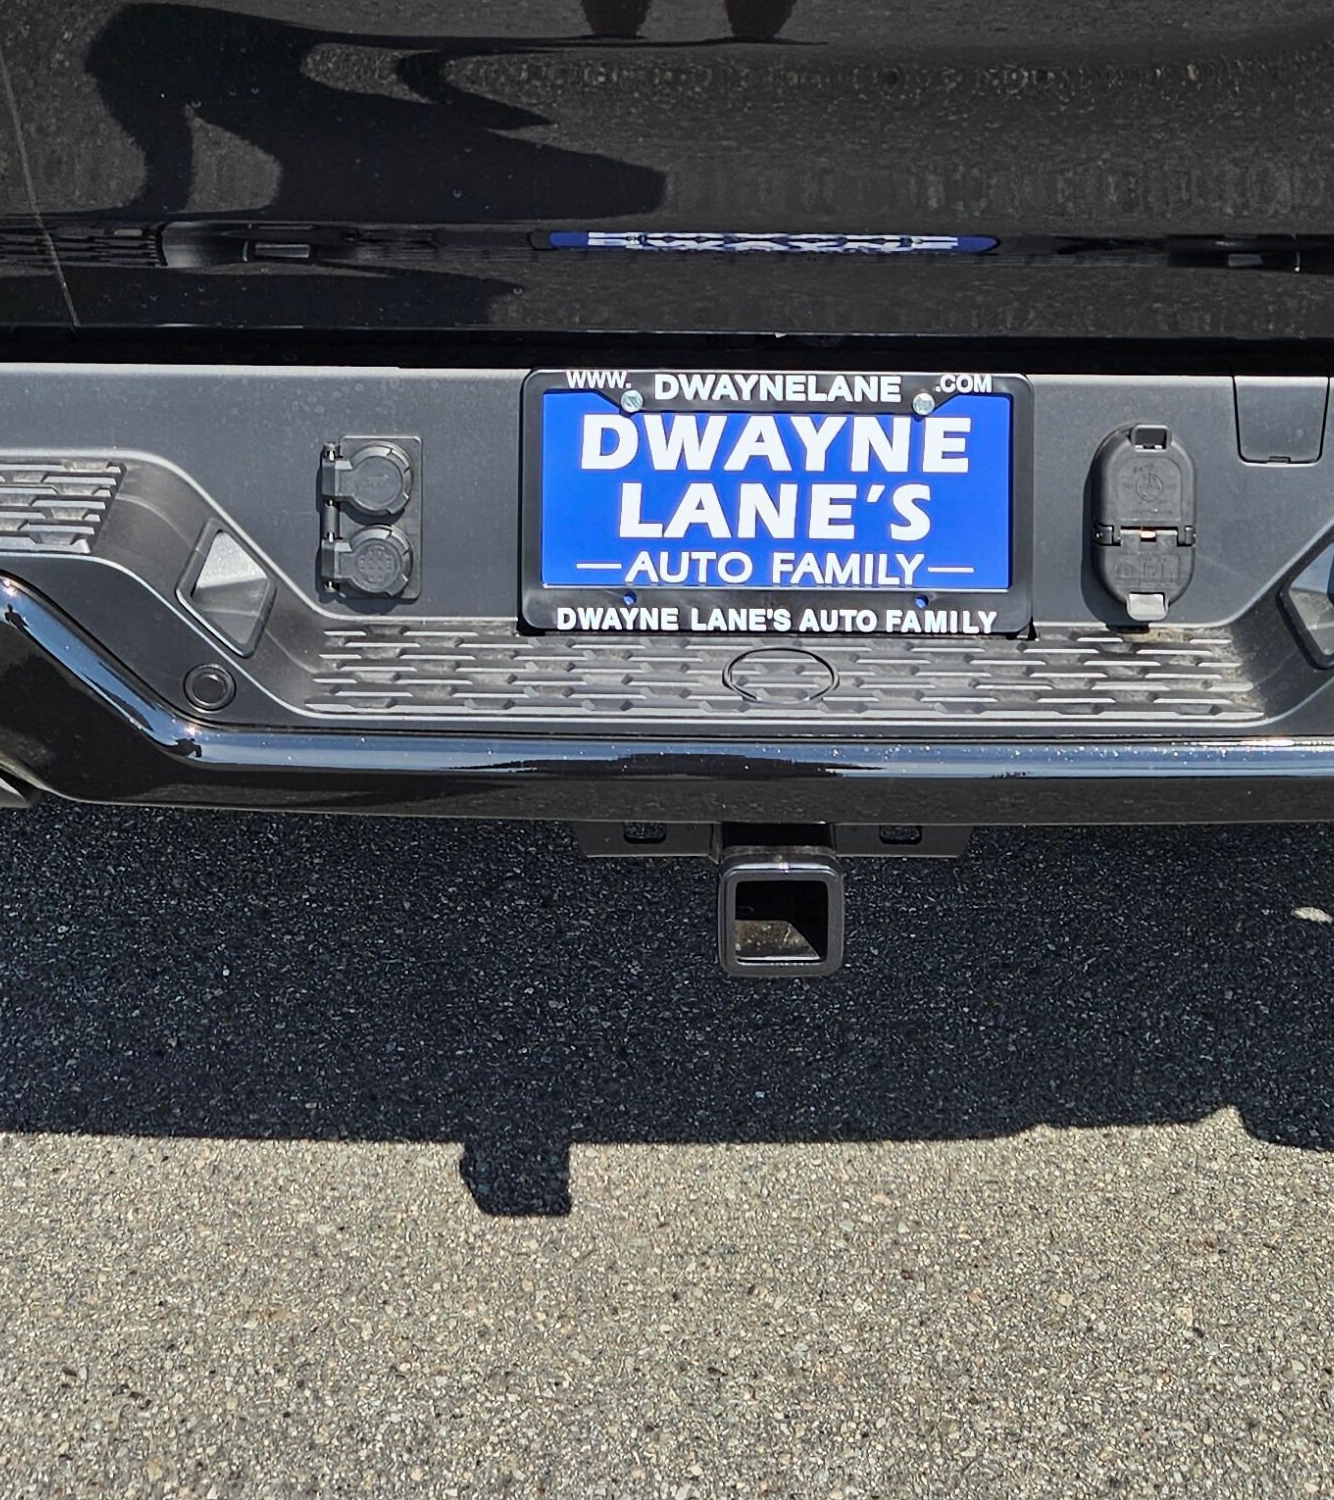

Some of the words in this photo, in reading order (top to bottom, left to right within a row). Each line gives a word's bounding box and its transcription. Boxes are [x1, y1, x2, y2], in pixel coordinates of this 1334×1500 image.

[567, 370, 631, 389] WWW.
[654, 373, 901, 403] DWAYNELANE
[935, 373, 993, 393] .COM
[581, 414, 972, 474] DWAYNE
[619, 482, 932, 541] LANE'S
[625, 551, 753, 585] AUTO
[772, 552, 925, 587] FAMILY
[557, 607, 679, 632] DWAYNE
[690, 608, 792, 632] LANE'S
[799, 609, 878, 633] AUTO
[885, 610, 998, 635] FAMILY
